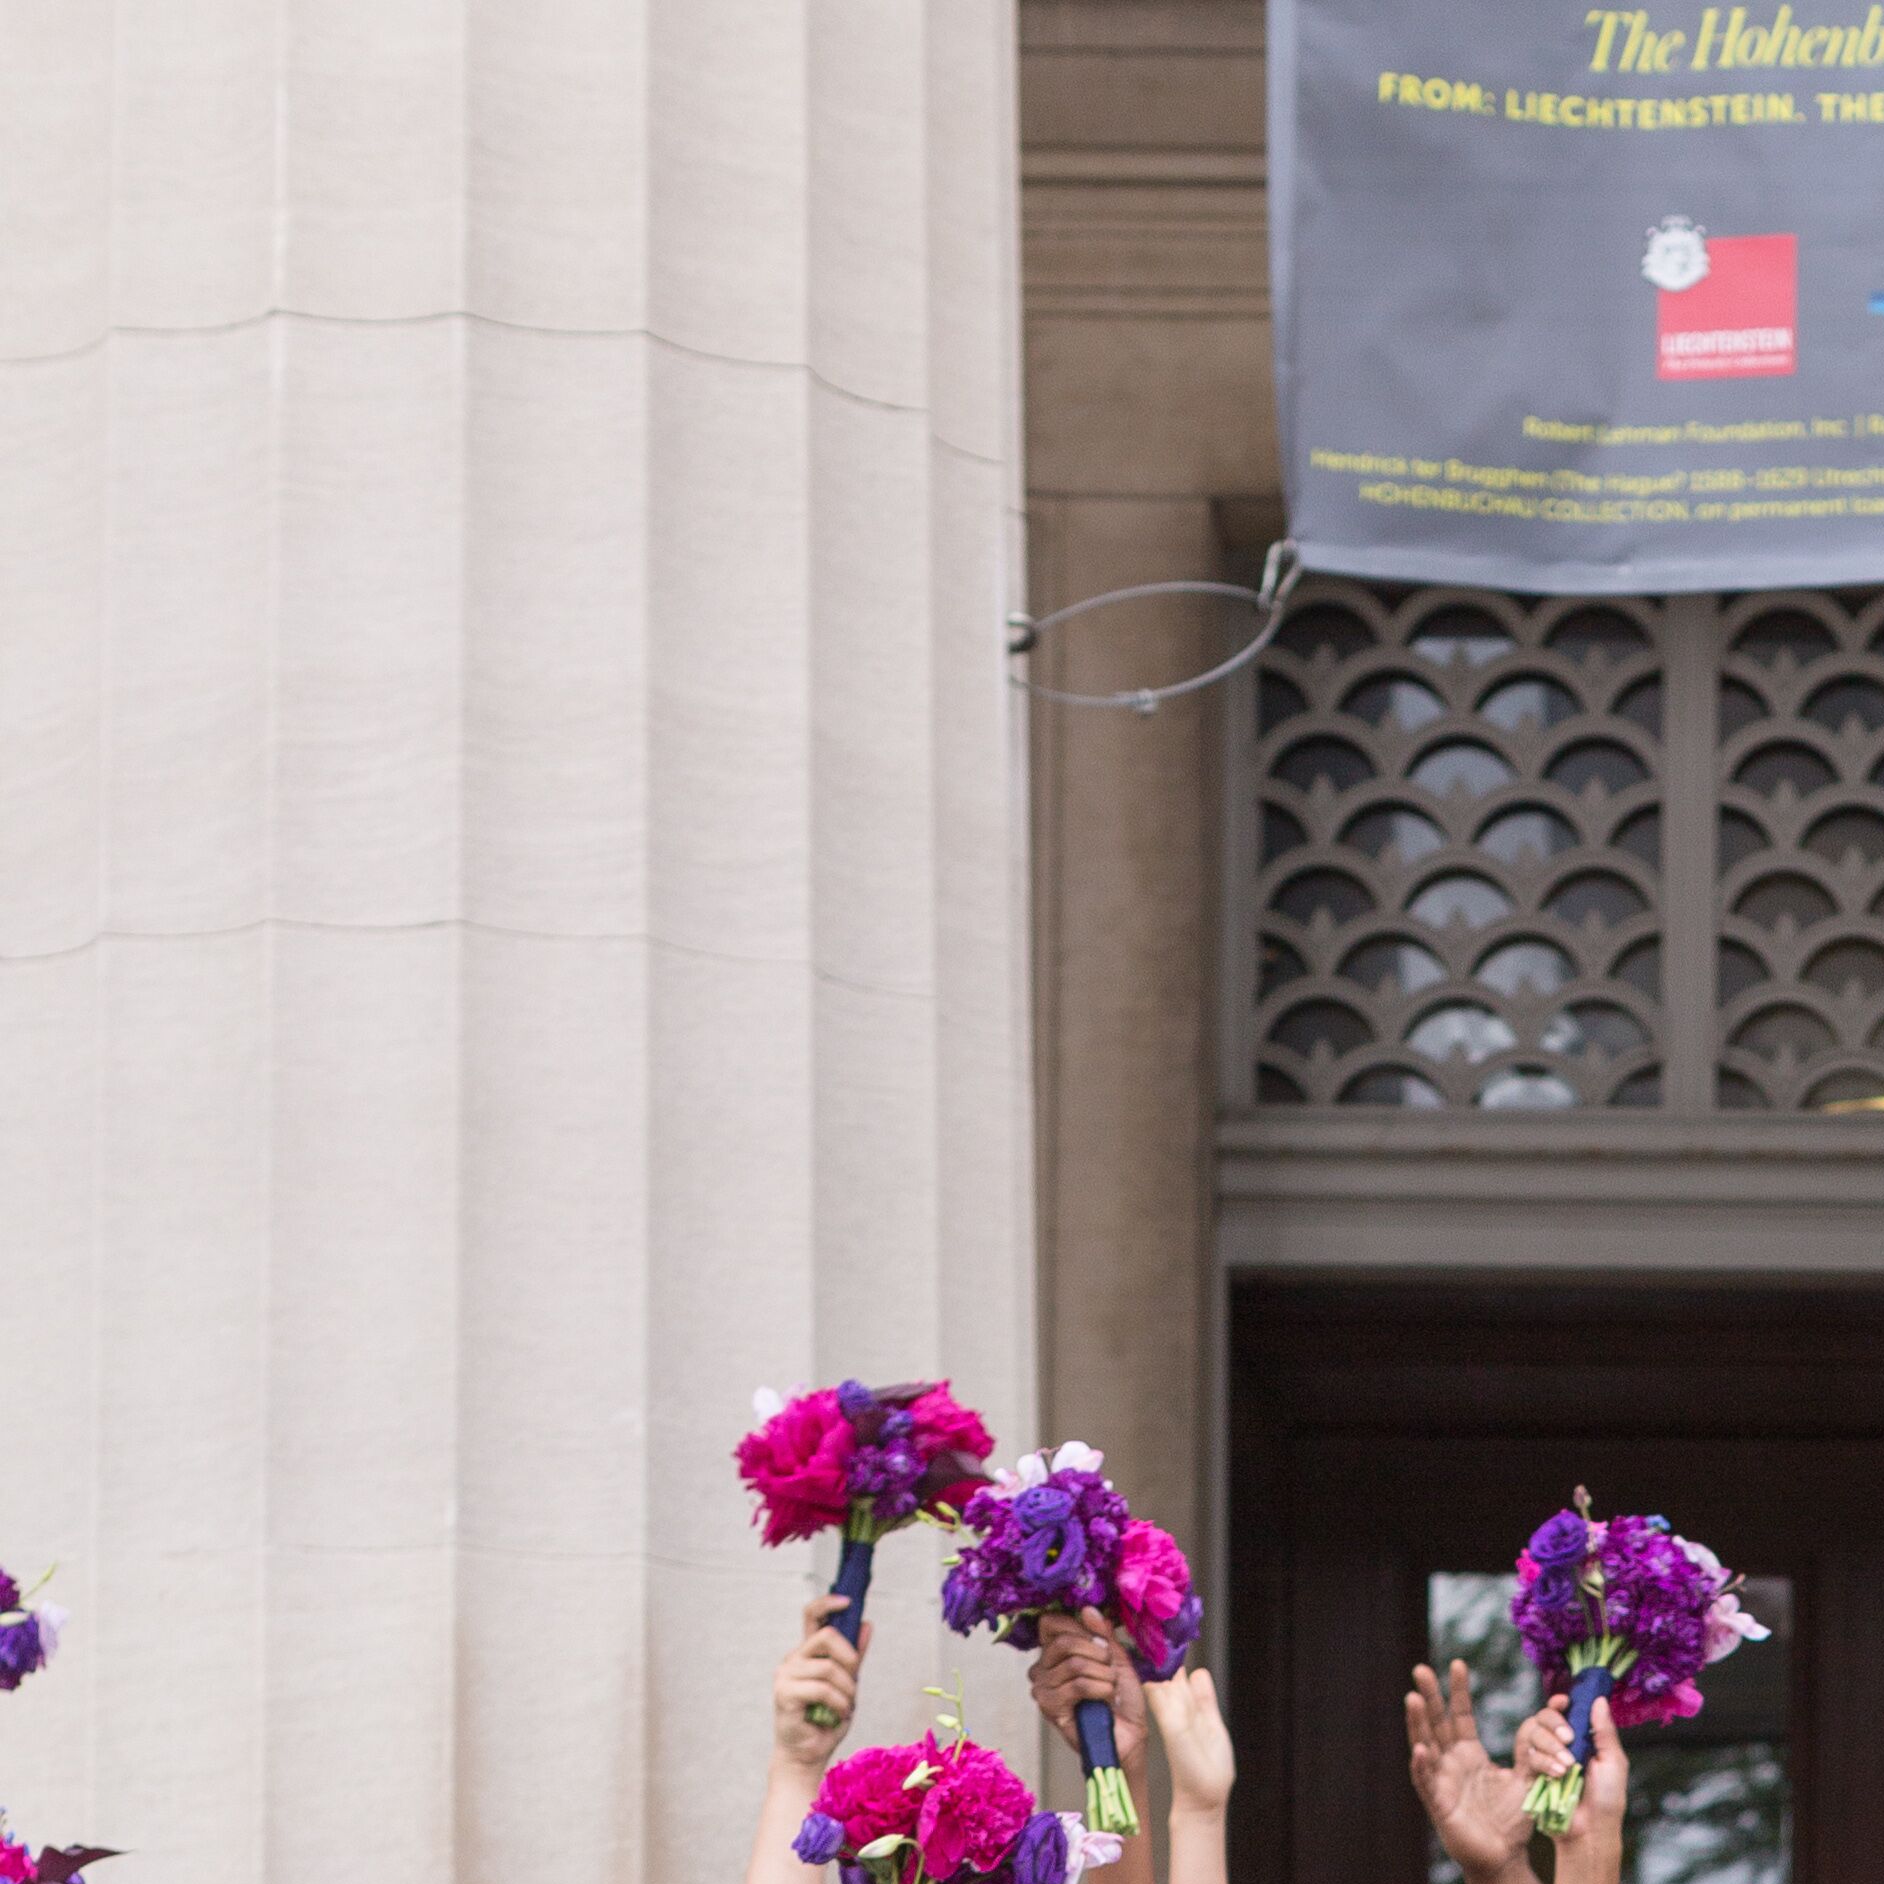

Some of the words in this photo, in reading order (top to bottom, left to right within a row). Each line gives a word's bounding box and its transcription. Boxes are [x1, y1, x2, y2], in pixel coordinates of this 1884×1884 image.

[1586, 10, 1687, 72] The
[1378, 72, 1496, 113] FROM:
[1504, 90, 1806, 129] LIECHTENSTEIN.
